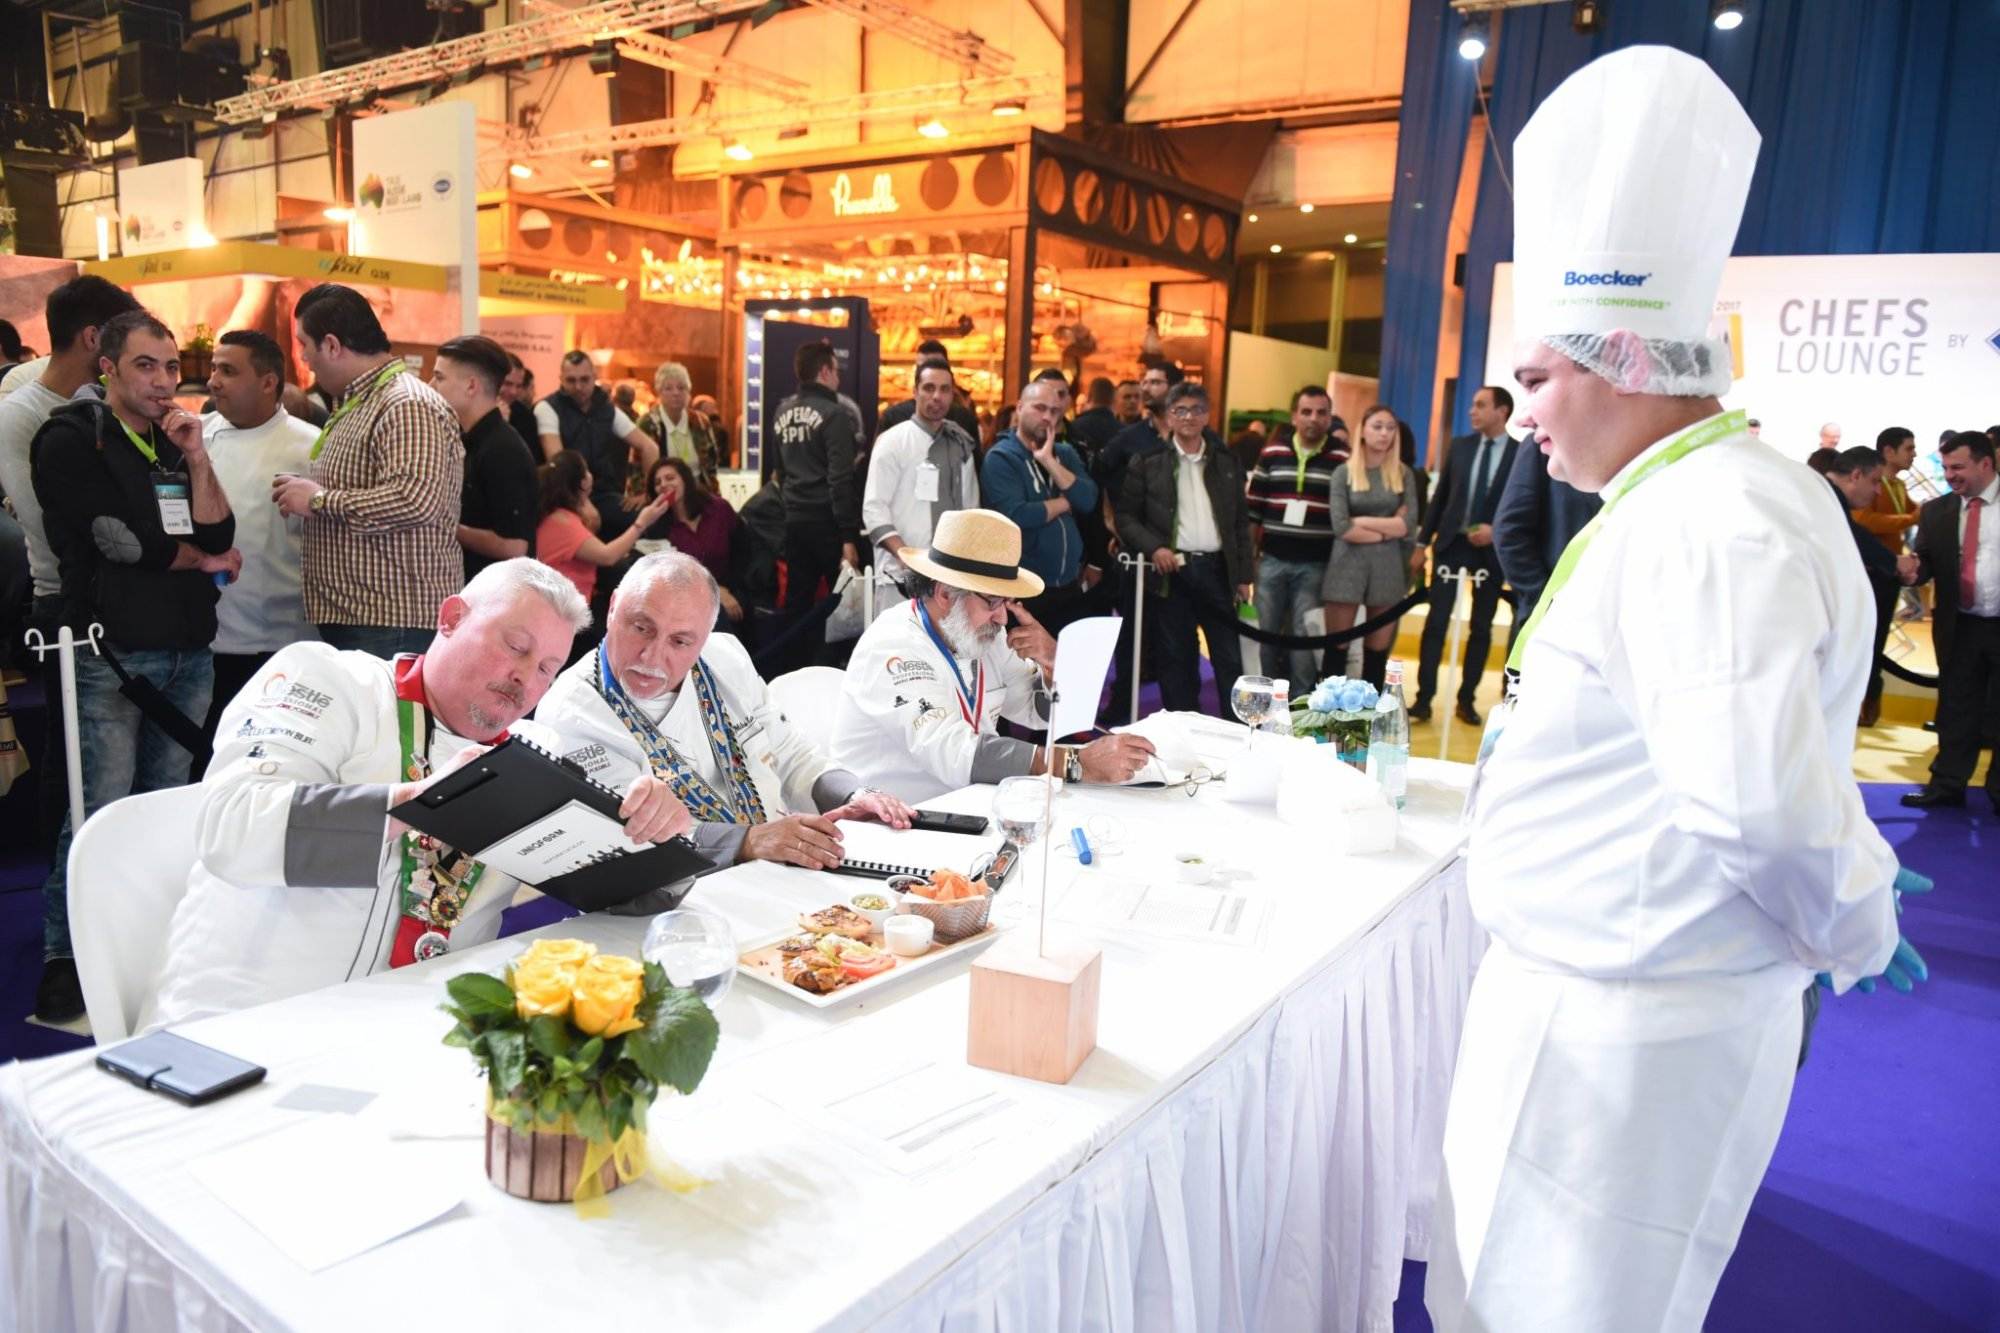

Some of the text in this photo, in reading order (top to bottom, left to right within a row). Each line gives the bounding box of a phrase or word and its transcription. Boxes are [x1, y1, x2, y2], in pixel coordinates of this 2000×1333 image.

[1564, 270, 1648, 287] Boecker
[1597, 297, 1665, 311] CONFIDENCE
[1716, 301, 1741, 312] 2017
[1779, 298, 1929, 338] CHEFS
[1777, 334, 1969, 376] LOUNGE BY
